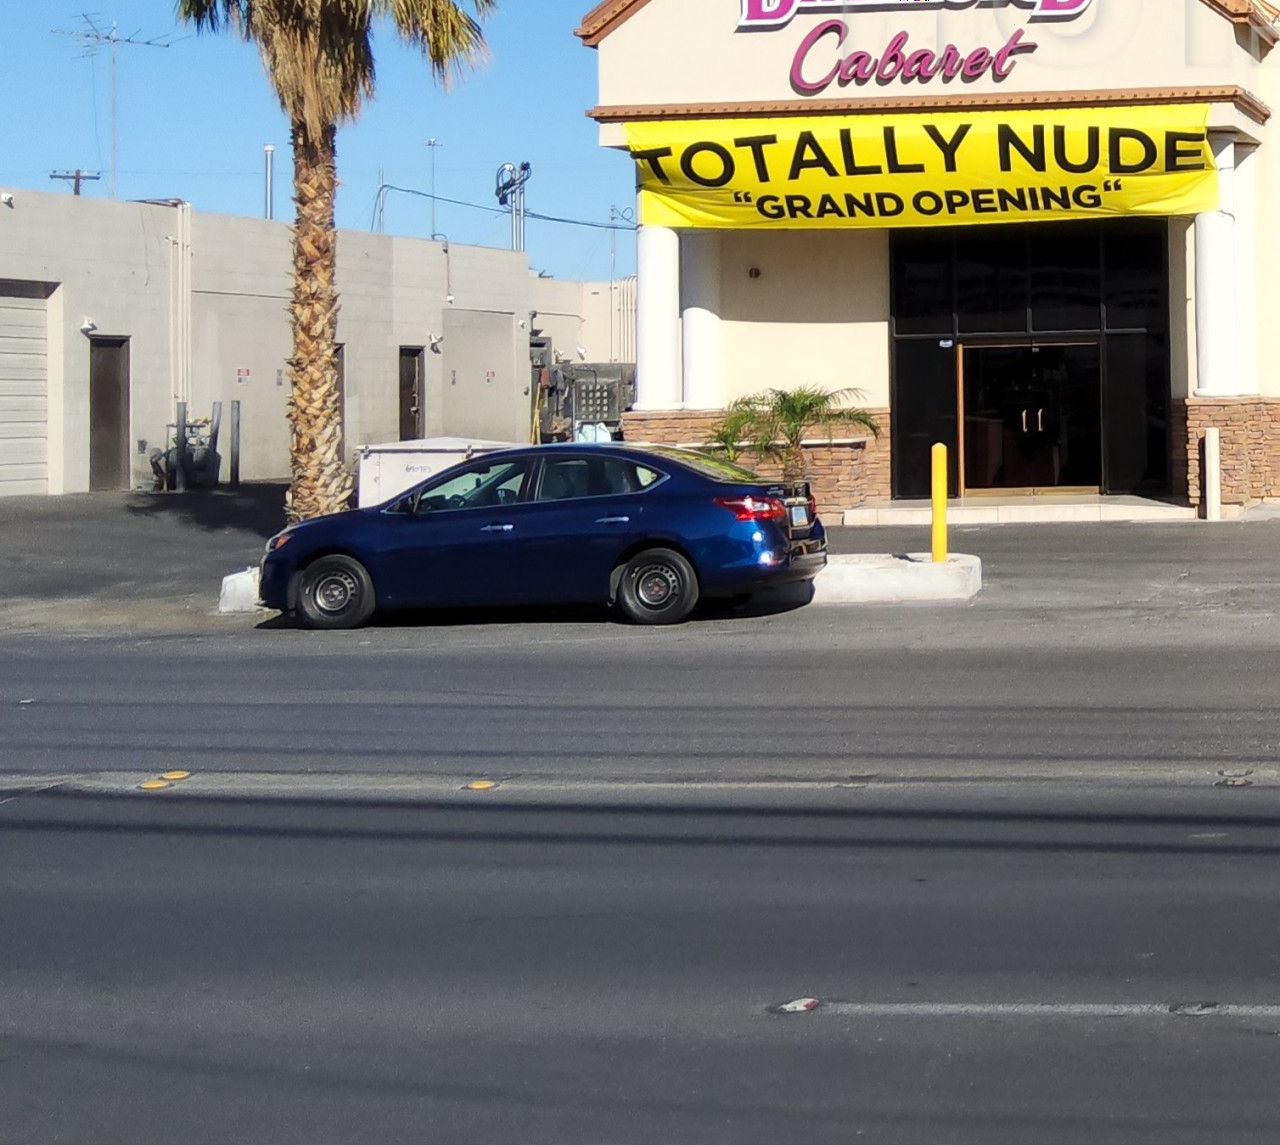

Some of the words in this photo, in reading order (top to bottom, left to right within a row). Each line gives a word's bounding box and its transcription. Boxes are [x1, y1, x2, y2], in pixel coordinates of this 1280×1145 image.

[789, 18, 1037, 94] Cabaret
[630, 123, 973, 188] TOTALLY
[997, 123, 1206, 174] NUDE
